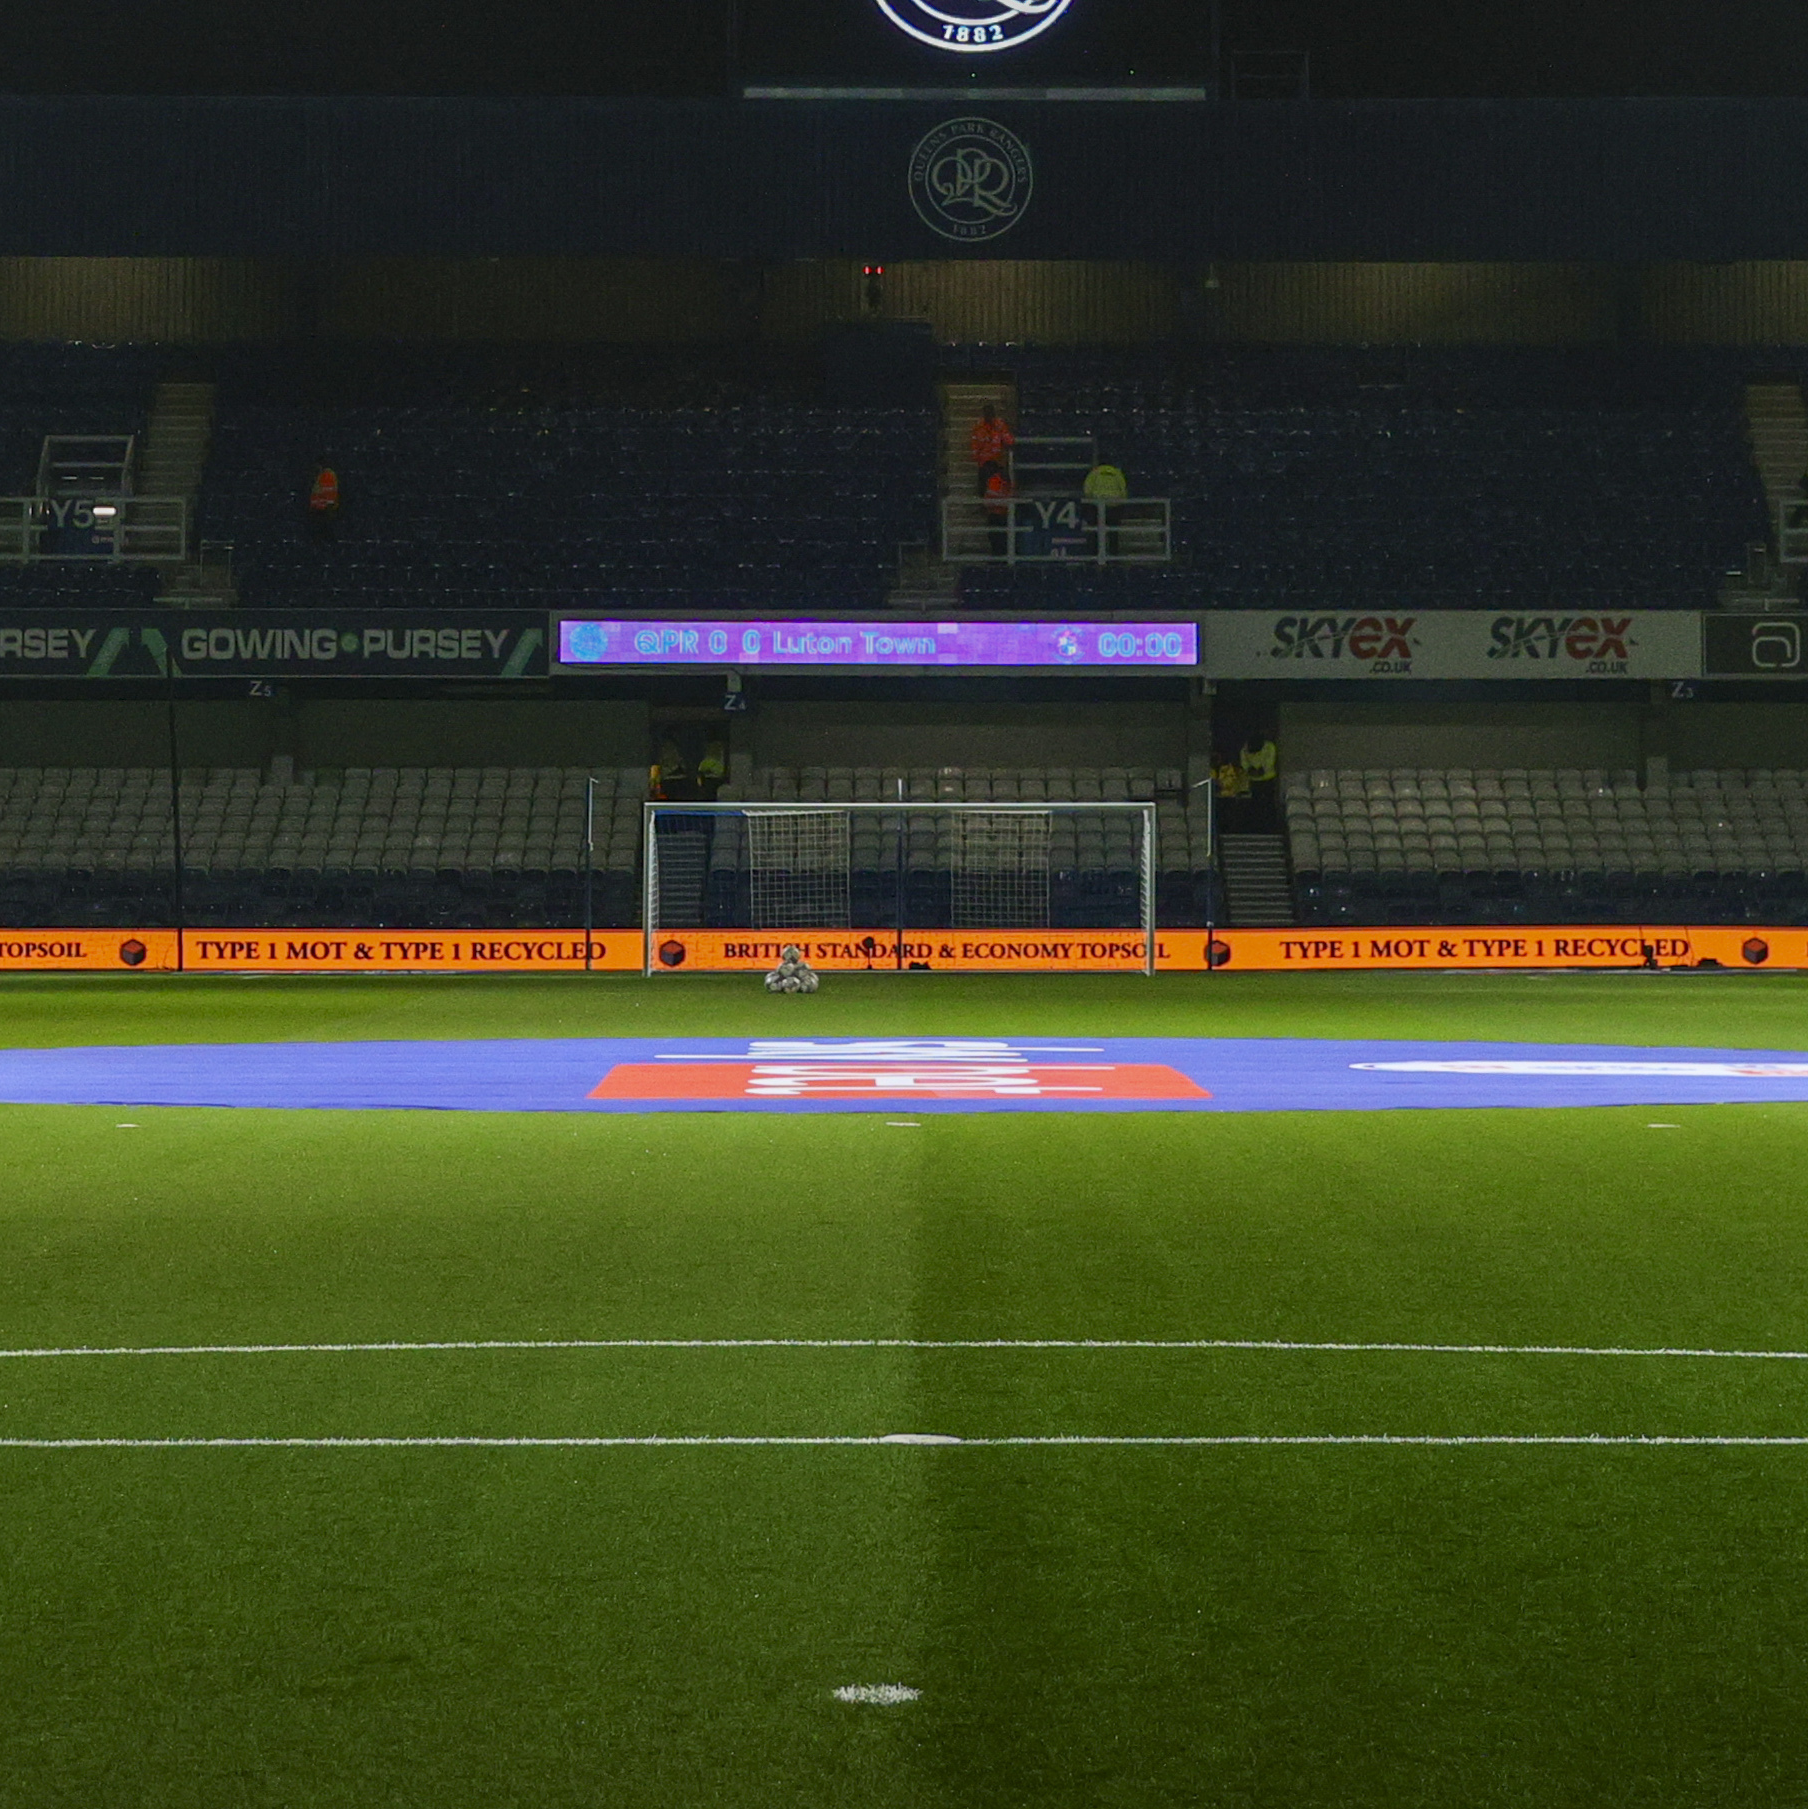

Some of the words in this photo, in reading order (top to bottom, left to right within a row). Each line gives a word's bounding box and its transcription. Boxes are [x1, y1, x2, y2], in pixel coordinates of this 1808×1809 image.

[942, 24, 1004, 43] 1882
[51, 498, 95, 528] Y5
[1034, 500, 1079, 529] Y4
[181, 628, 337, 659] GOWING
[363, 628, 509, 659] PURSEY
[634, 629, 699, 653] QPR
[773, 631, 852, 654] Luton
[860, 631, 935, 655] Town
[1098, 632, 1181, 657] 00:00
[196, 942, 260, 960] TYPE
[268, 942, 277, 960] 1
[286, 942, 347, 960] MOT
[354, 942, 374, 960] &
[380, 942, 445, 960] TYPE
[453, 942, 461, 960] 1
[471, 942, 606, 960] RECYCLED
[724, 943, 810, 959] BRITIH
[940, 943, 955, 960] &
[962, 943, 1074, 959] ECONOMY
[1077, 943, 1170, 959] TOPSOL
[1280, 940, 1344, 959] TYPE
[1353, 940, 1361, 958] 1
[1369, 940, 1430, 958] MOT
[1438, 940, 1457, 958] &
[1464, 939, 1527, 958] TYPE
[1535, 939, 1543, 957] 1
